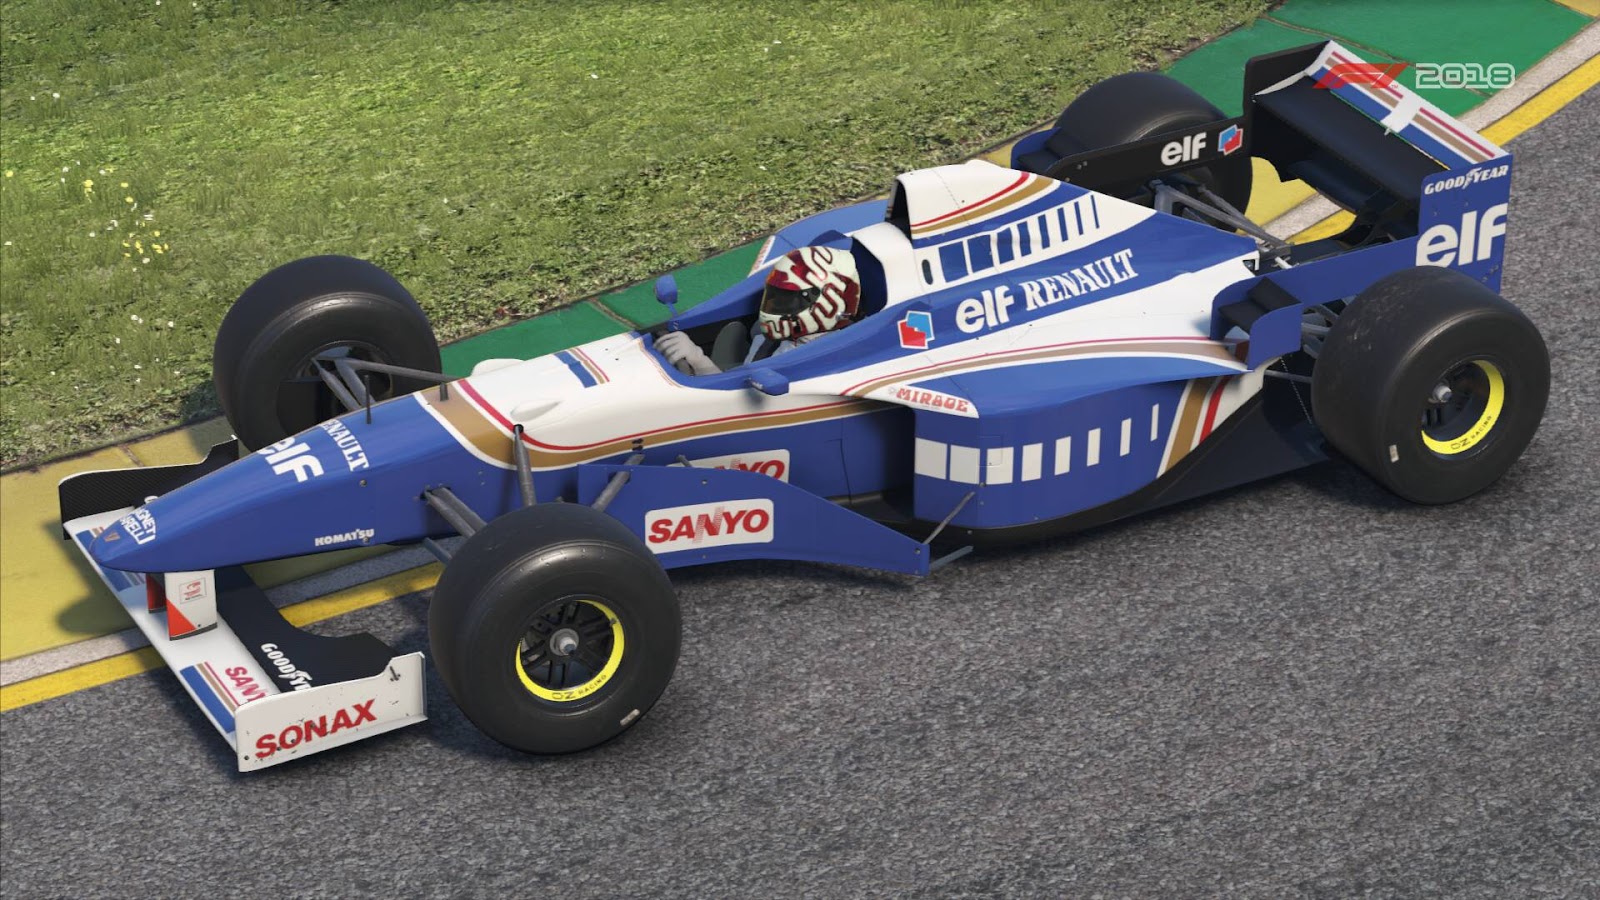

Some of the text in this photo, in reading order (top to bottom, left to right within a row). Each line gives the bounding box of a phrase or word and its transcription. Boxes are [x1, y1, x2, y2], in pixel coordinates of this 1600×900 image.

[1161, 132, 1207, 166] elf
[1424, 165, 1509, 195] GOODYEAR
[1416, 203, 1508, 267] elf
[955, 248, 1138, 333] elf RENAULT
[896, 388, 968, 412] MIRAGE
[320, 419, 369, 472] ENAULT
[315, 528, 375, 546] KOMATSU
[648, 506, 770, 544] SANYO
[255, 698, 378, 759] SONAX
